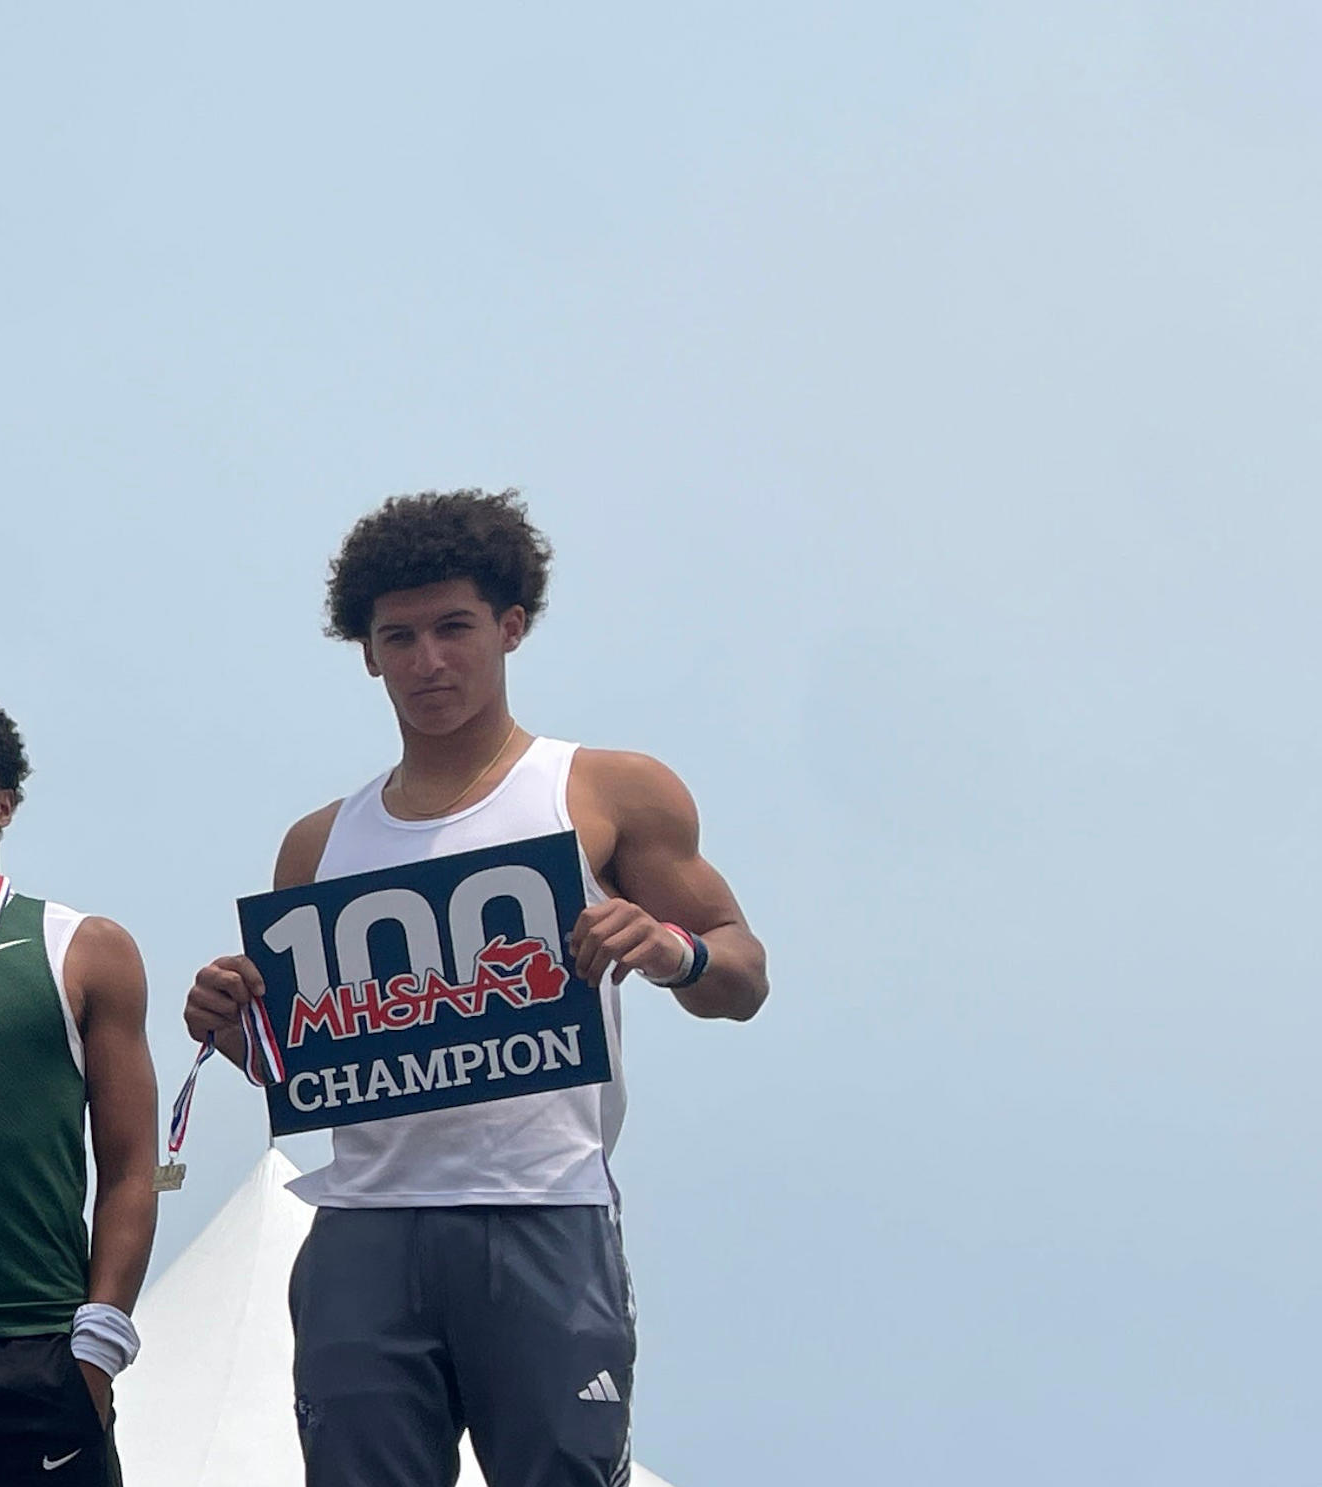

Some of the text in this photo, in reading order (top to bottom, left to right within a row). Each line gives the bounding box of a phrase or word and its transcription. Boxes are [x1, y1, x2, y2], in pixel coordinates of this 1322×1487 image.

[263, 865, 562, 1000] 100
[287, 967, 539, 1048] MHSAA
[288, 1024, 582, 1113] CHAMPION
